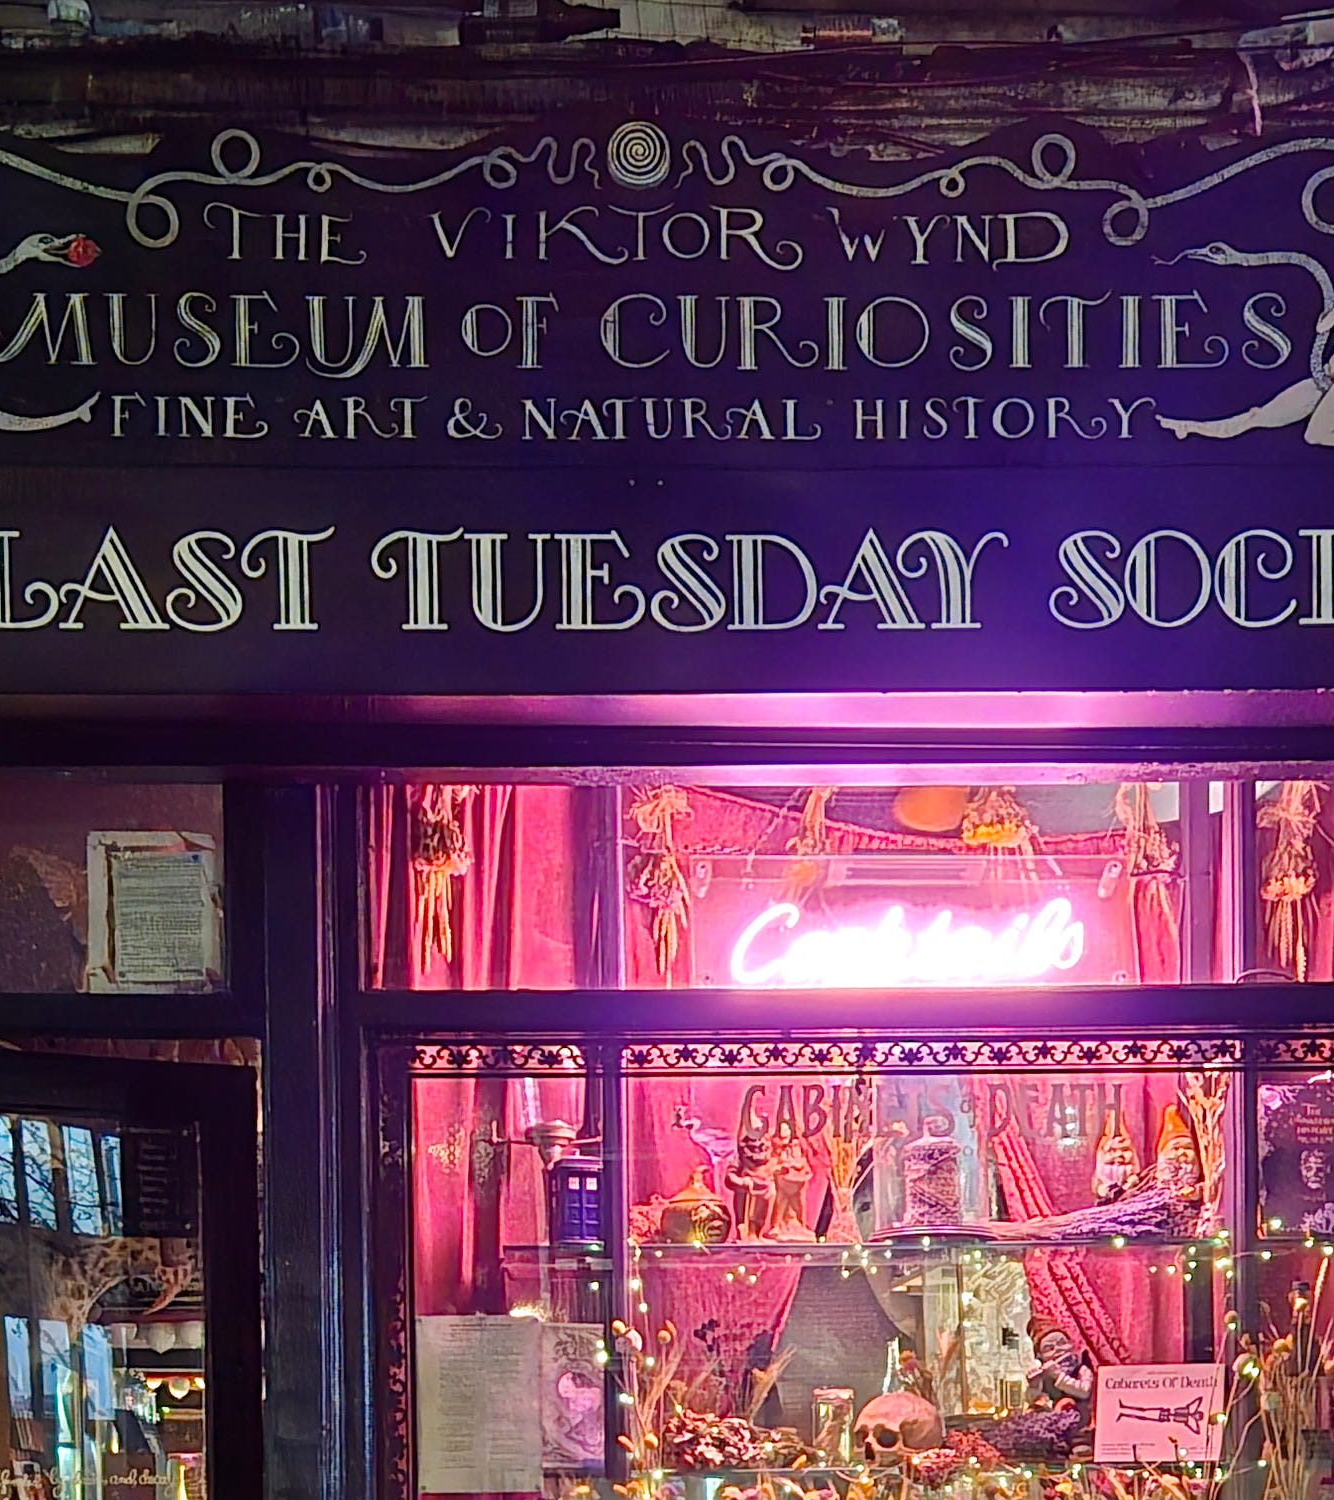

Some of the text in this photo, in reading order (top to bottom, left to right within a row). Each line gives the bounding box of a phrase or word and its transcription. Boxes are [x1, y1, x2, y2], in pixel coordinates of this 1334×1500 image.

[204, 202, 1069, 271] THE VIKTOR WYND
[461, 292, 559, 369] OF
[600, 289, 1293, 371] CURIOSITIES
[110, 391, 1159, 443] FINE ART & NATURAL HISTORY
[370, 526, 1010, 633] TUESDAY
[731, 897, 1084, 984] Cktils
[987, 1082, 1124, 1139] DEATH
